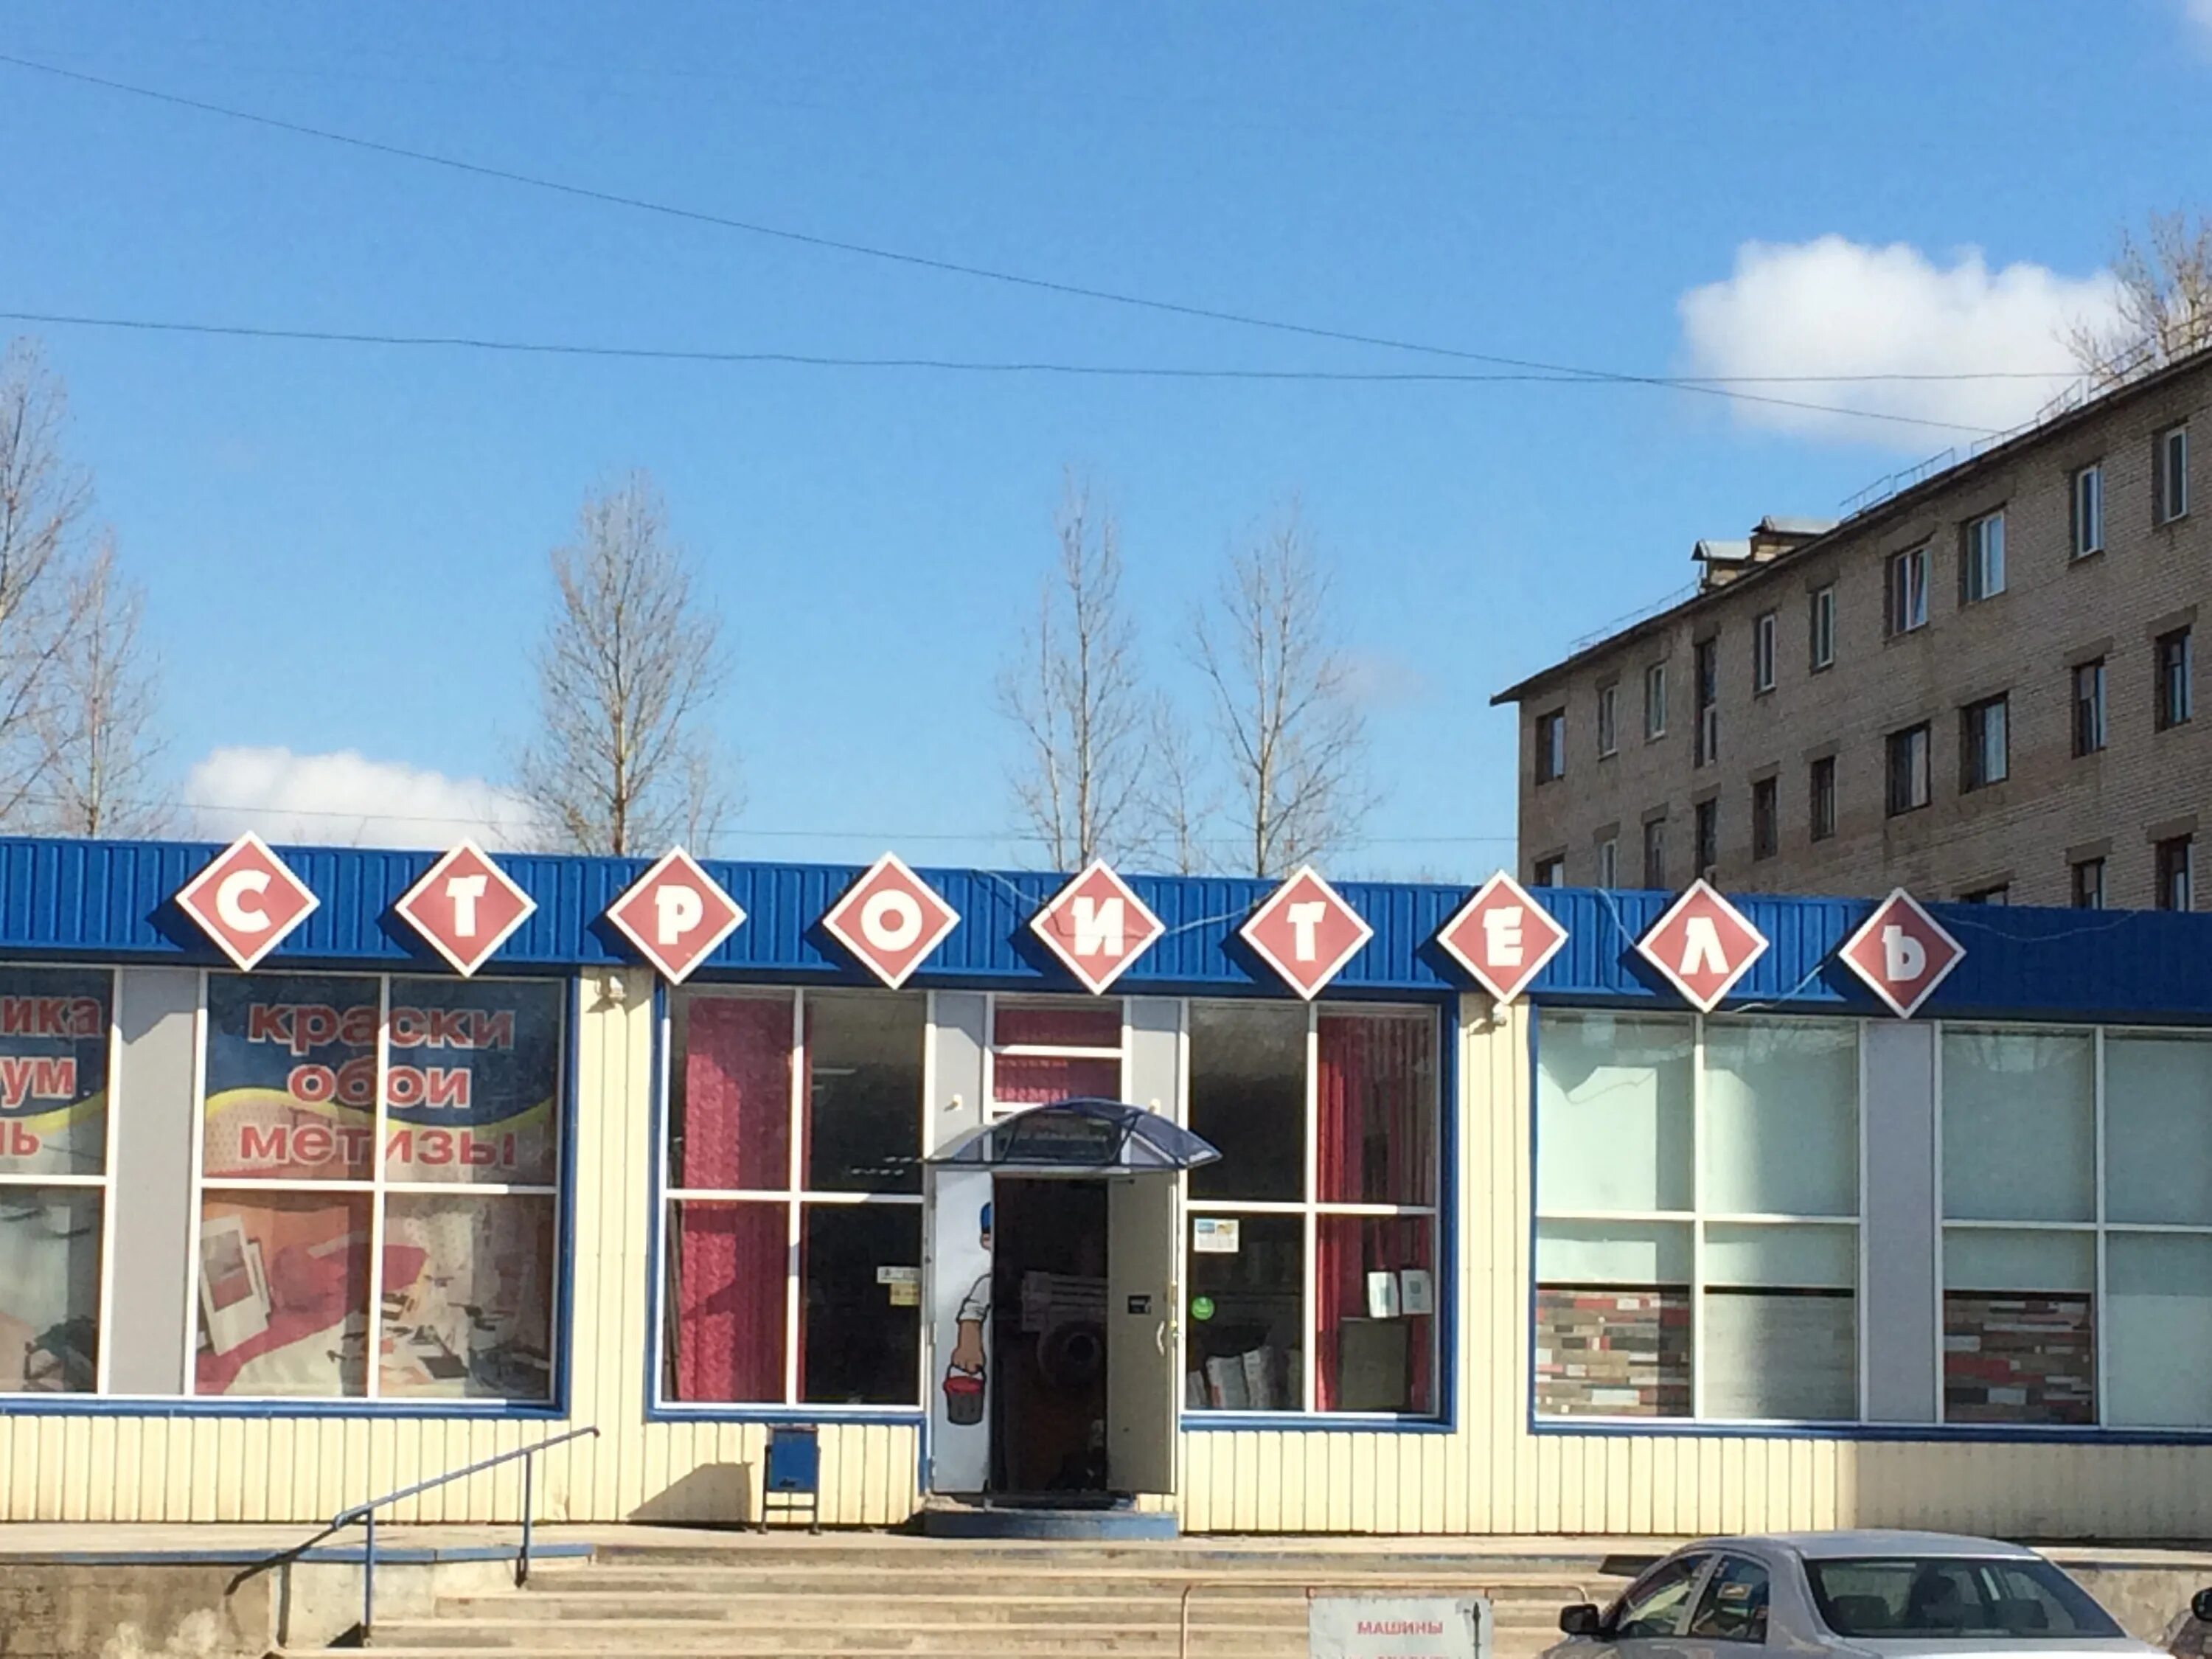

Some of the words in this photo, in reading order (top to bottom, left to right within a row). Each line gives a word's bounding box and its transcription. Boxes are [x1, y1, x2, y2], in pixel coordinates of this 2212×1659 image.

[215, 869, 1927, 982] СТРОИТЕЛЬ
[248, 1003, 515, 1056] краски
[288, 1054, 472, 1109] обои
[238, 1123, 519, 1168] метизы
[1357, 1621, 1444, 1635] МАШИНЫ
